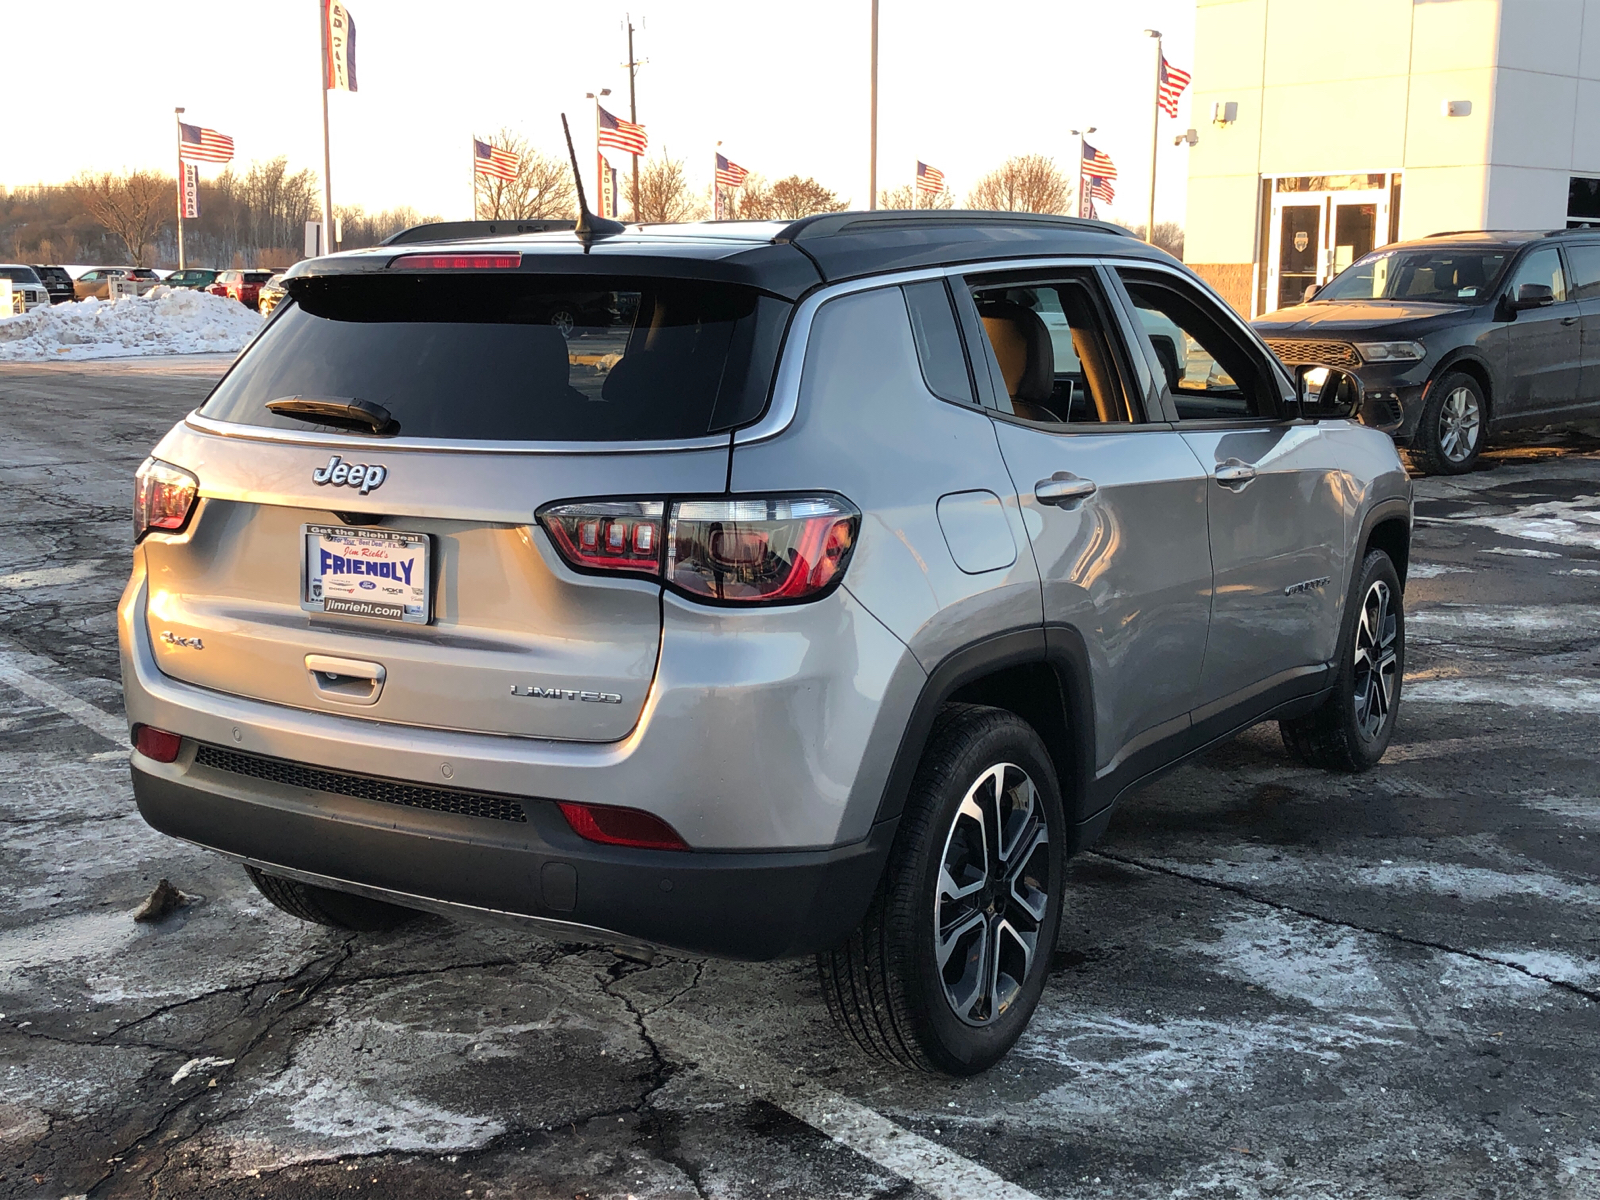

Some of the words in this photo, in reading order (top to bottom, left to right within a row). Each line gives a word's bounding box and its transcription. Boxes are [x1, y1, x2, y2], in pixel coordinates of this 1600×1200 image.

[313, 454, 387, 495] Jeep
[310, 526, 332, 535] Get
[335, 528, 355, 536] the
[358, 530, 388, 539] Riehl
[392, 533, 419, 542] Deal
[343, 546, 359, 557] Jim
[361, 547, 389, 559] Riehl's
[320, 547, 415, 586] FRIENDLY
[326, 600, 402, 617] jimriehl.com
[510, 685, 623, 704] LIMITED
